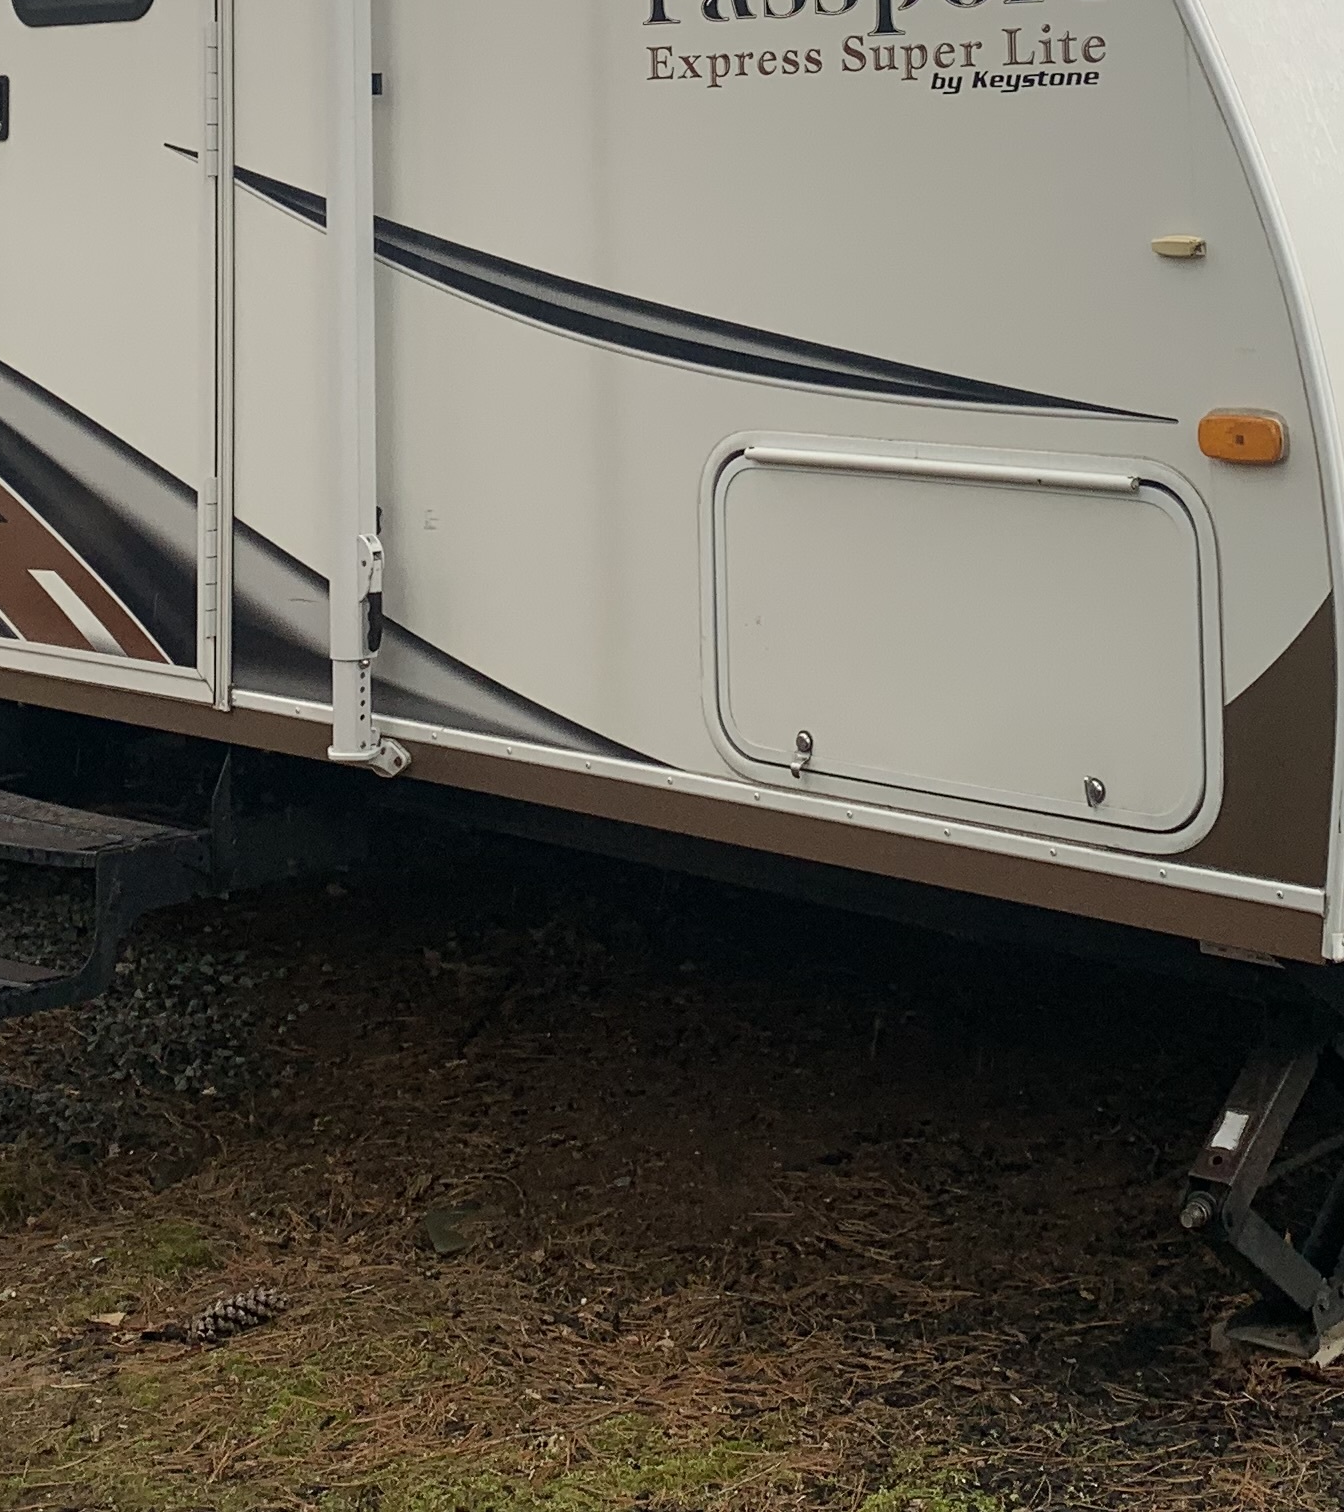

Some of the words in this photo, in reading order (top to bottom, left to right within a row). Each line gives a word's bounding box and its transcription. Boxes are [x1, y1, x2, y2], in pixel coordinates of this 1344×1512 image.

[645, 45, 823, 89] Express
[841, 34, 983, 81] Super
[1001, 23, 1107, 67] Lite
[930, 72, 963, 95] by
[971, 70, 1100, 94] Keystone
